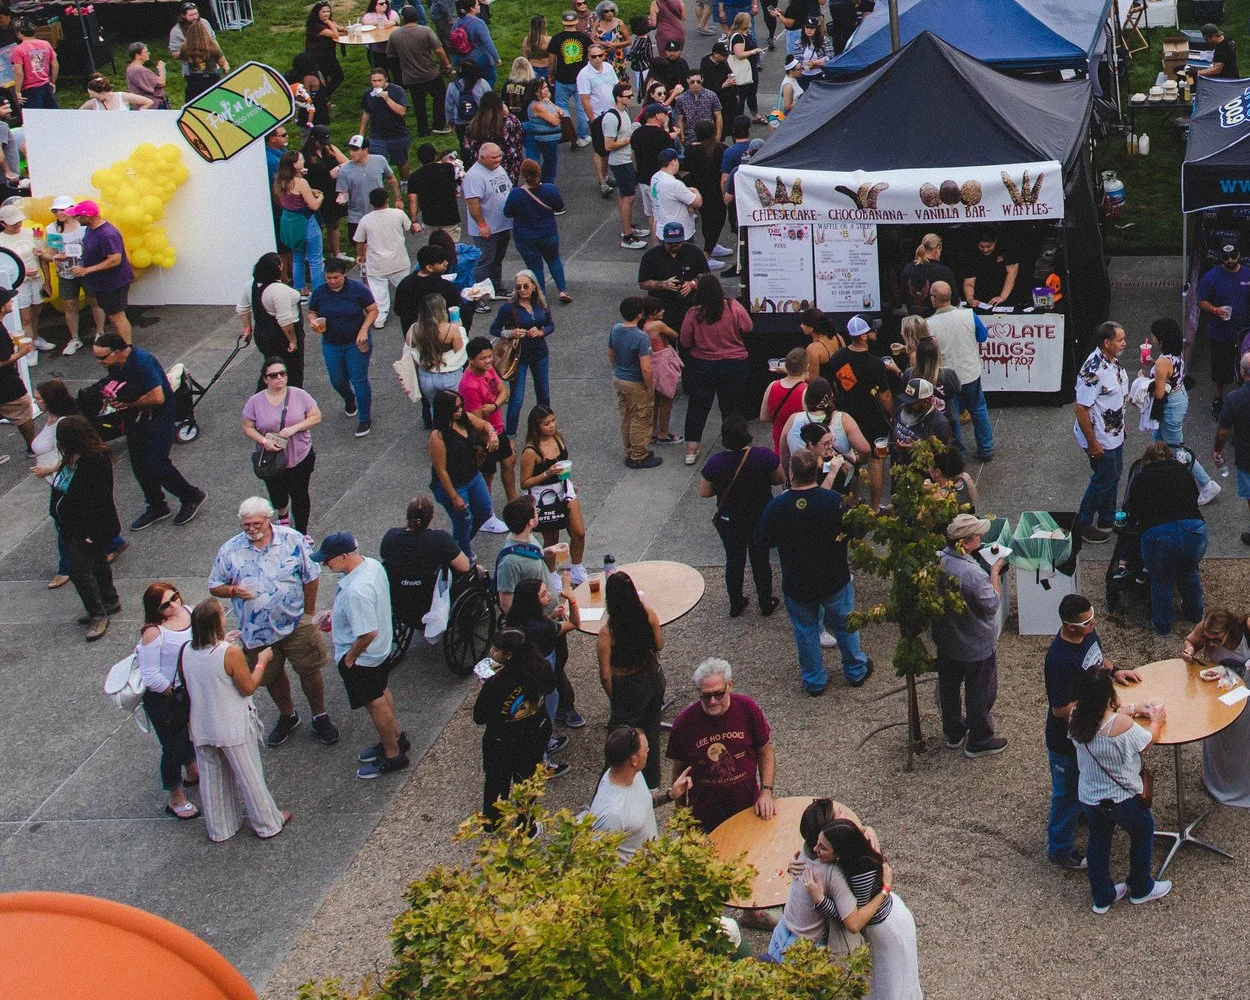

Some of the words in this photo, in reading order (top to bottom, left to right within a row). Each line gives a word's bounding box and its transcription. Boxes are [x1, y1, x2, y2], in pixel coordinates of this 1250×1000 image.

[244, 73, 278, 108] Good
[915, 208, 960, 220] VANILLA
[979, 341, 1036, 357] HINGS
[552, 512, 565, 520] BAG
[696, 738, 709, 749] LEE
[709, 733, 721, 742] HO
[722, 731, 745, 740] FOOKS
